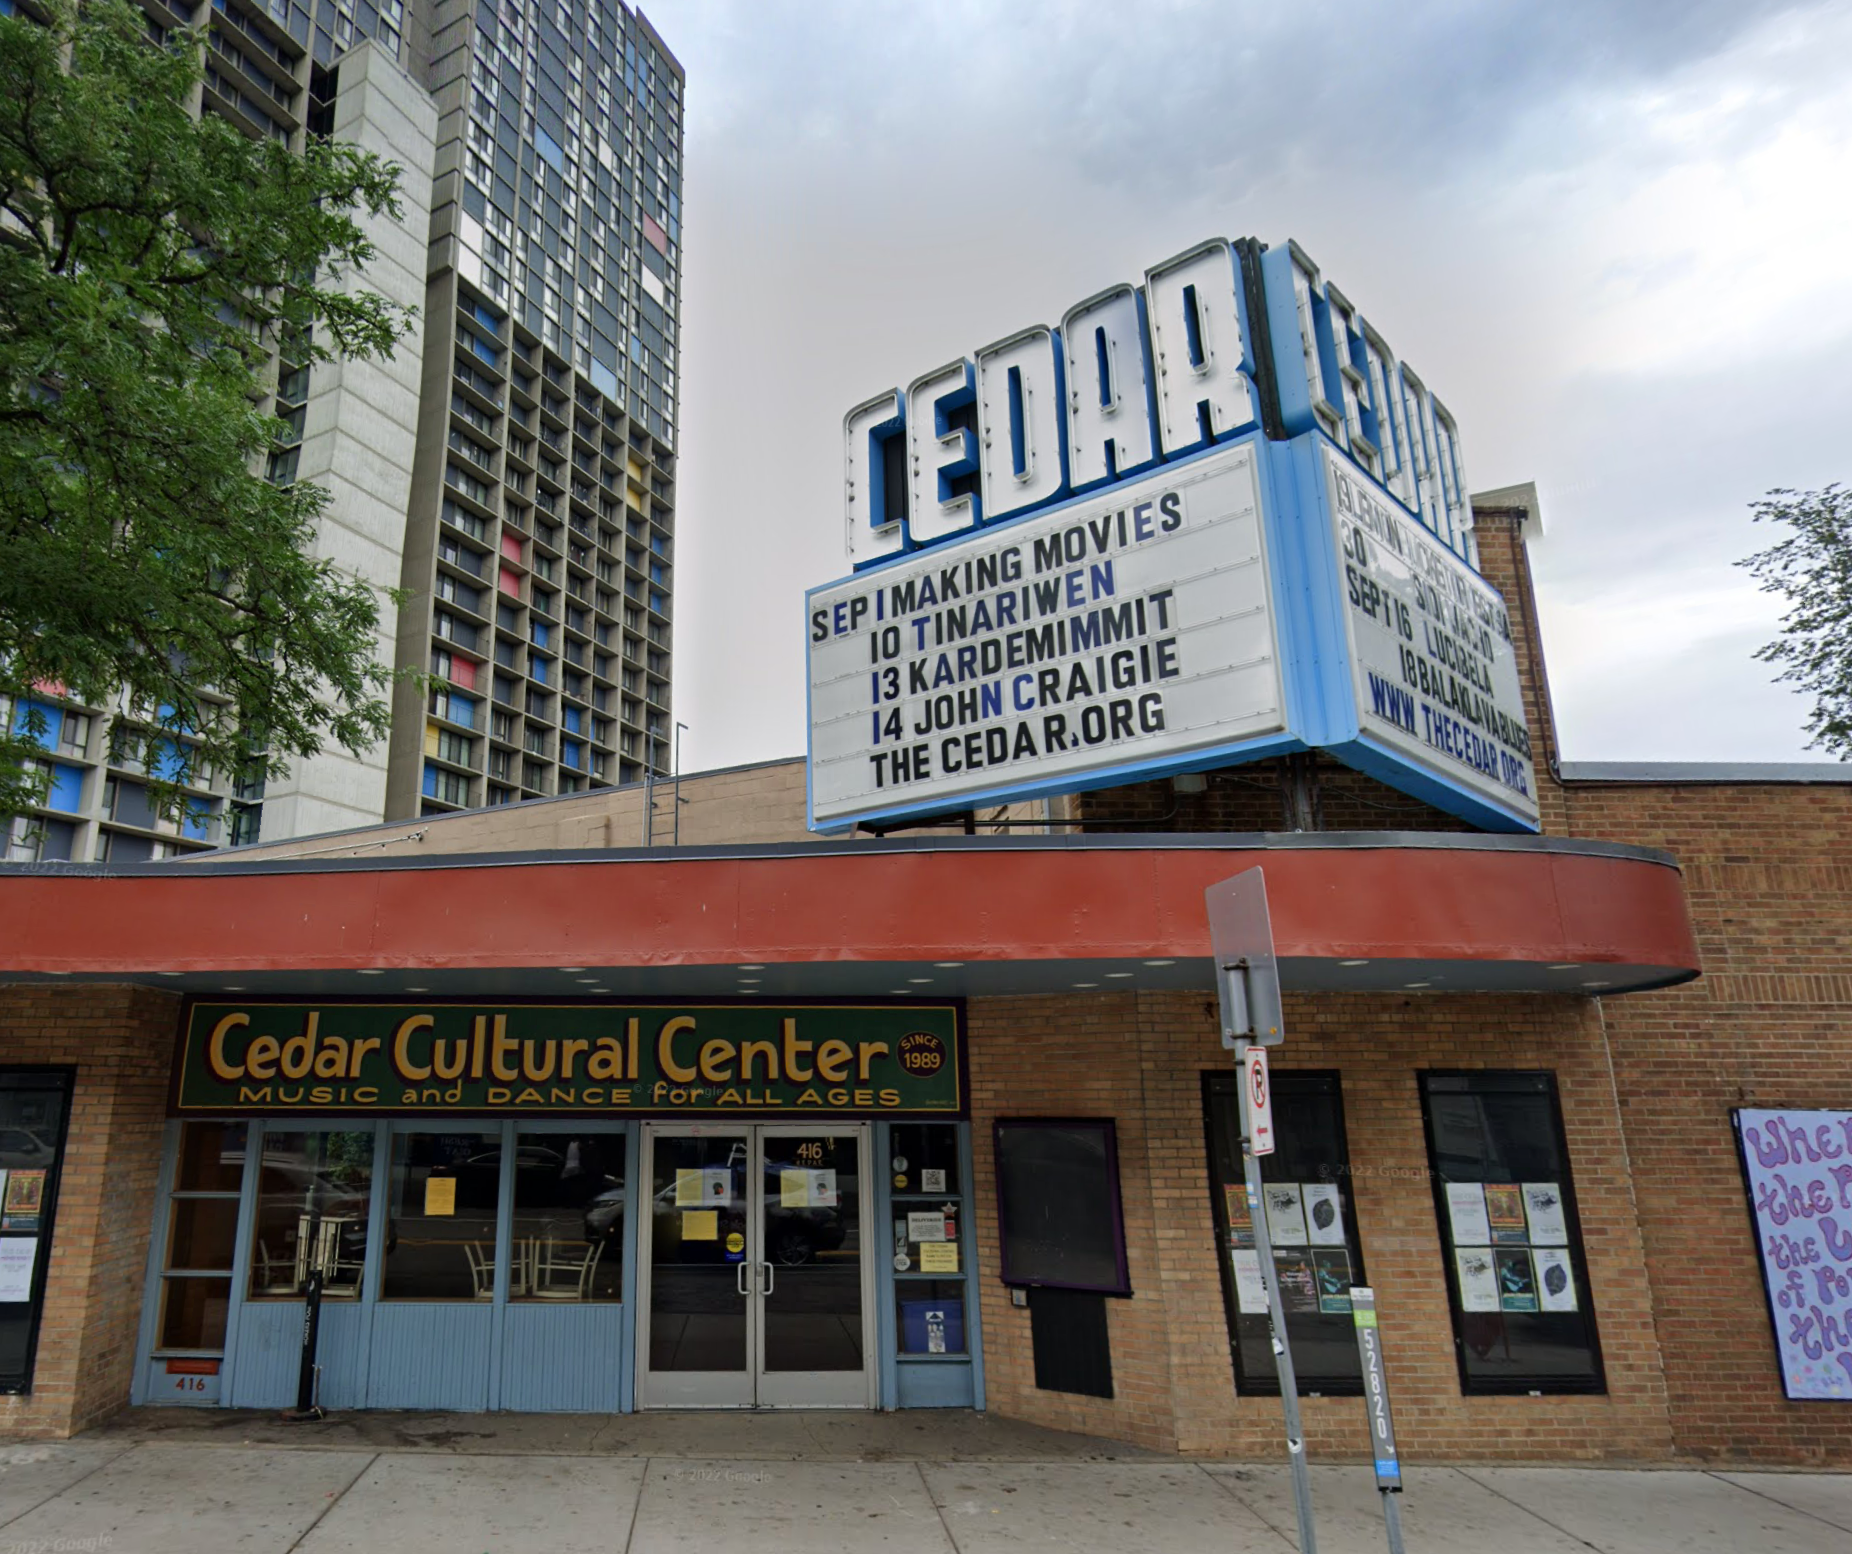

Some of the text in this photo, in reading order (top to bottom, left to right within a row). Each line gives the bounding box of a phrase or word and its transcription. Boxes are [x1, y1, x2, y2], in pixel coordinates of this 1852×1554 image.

[843, 237, 1258, 566] CEDAR
[812, 596, 868, 642] SEP
[891, 546, 1021, 618] MAKING
[1034, 492, 1182, 573] MOVIES
[1341, 519, 1367, 568] 30
[871, 559, 1116, 664] 10 TINARIWEN
[1346, 564, 1494, 699] SEPT 16 LUCIBELA
[872, 589, 1174, 704] 13 KARDEMIMMIT
[1399, 643, 1418, 688] 18
[873, 637, 1180, 745] 14 JOHN CRAIGIE
[1368, 671, 1528, 797] WWW THECEDAR ORG
[870, 743, 930, 788] THE
[208, 1011, 890, 1084] Cedar Cultural Center
[900, 1034, 939, 1050] SINCE
[903, 1052, 941, 1070] 1989
[239, 1078, 901, 1107] MUSIC and DANCE for ALL AGES
[796, 1142, 823, 1160] 416
[1757, 1173, 1834, 1226] the
[1768, 1234, 1821, 1270] the
[1777, 1270, 1804, 1309] of
[175, 1377, 205, 1391] 416
[1363, 1328, 1388, 1439] 52820
